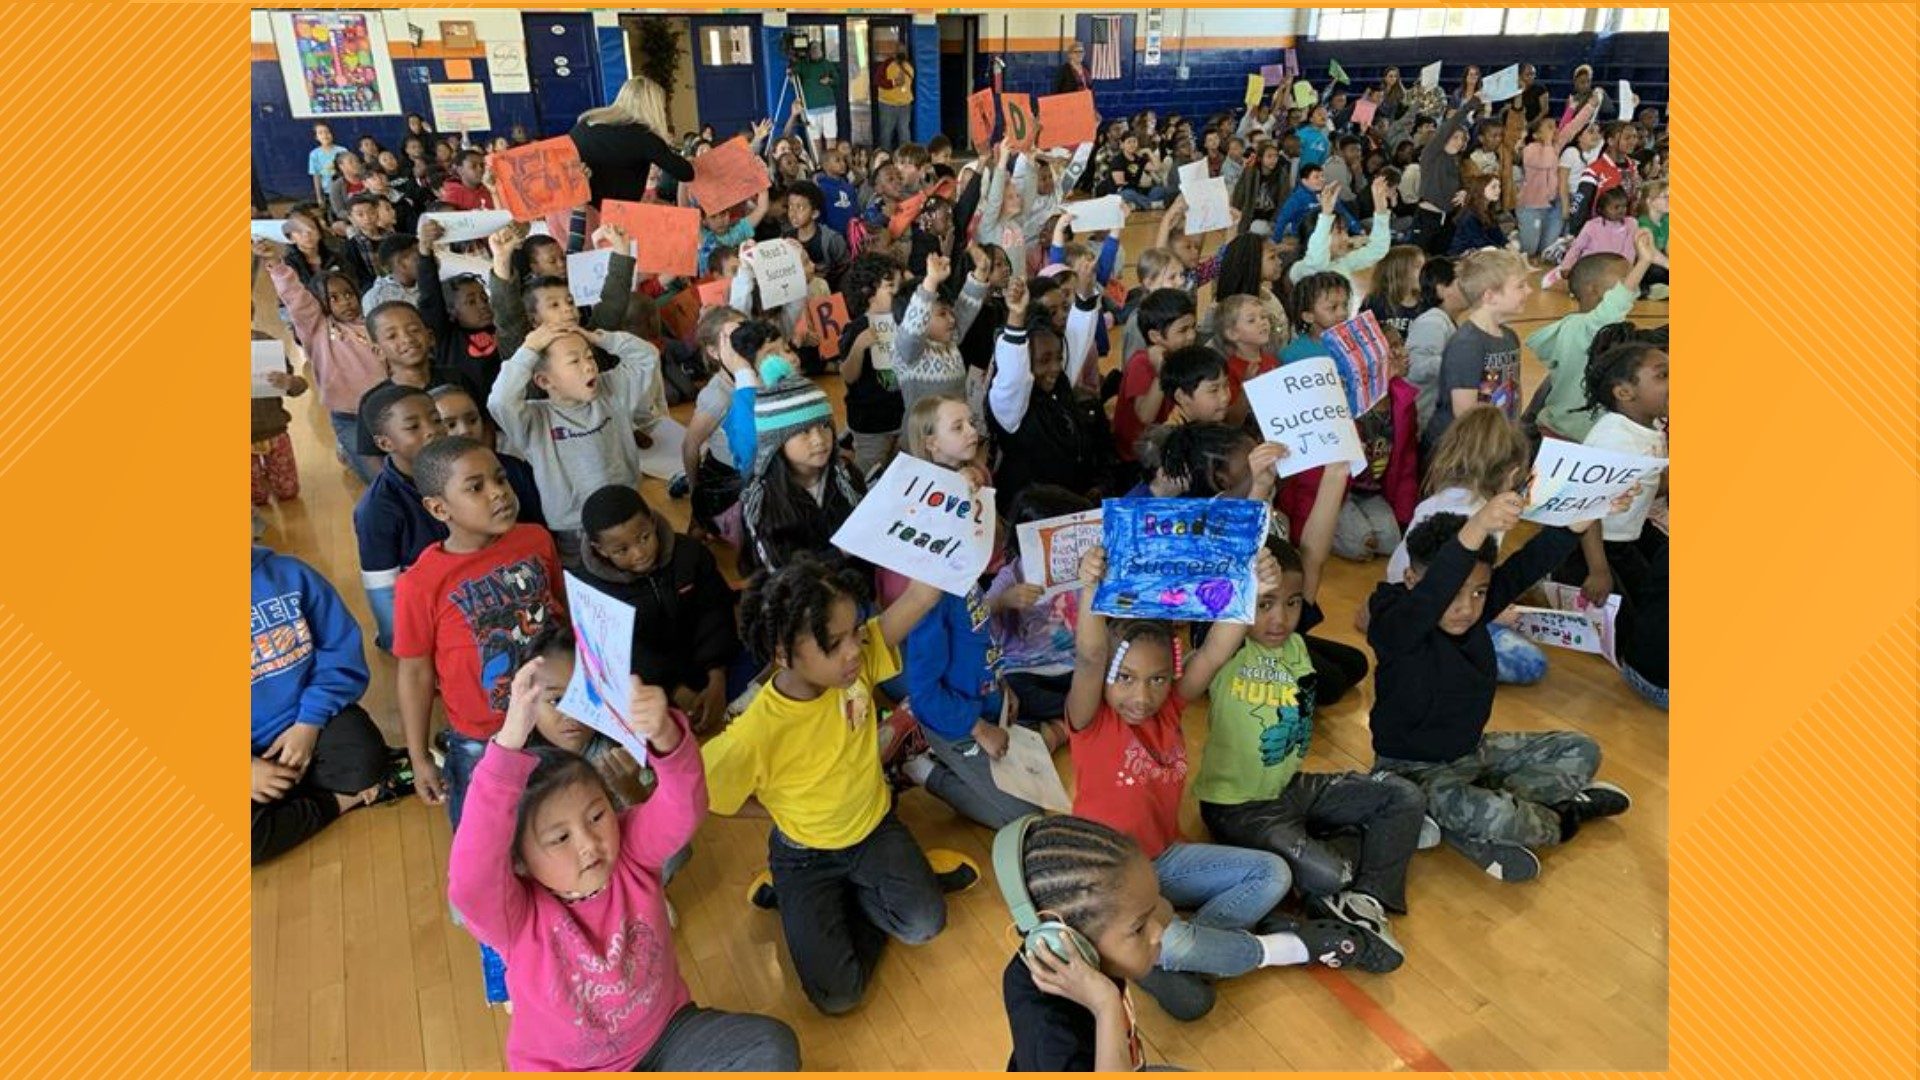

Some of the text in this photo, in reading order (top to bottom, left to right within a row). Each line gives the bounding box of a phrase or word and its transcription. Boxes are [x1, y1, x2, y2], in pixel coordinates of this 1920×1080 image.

[1008, 101, 1026, 140] D
[758, 245, 781, 260] Read
[766, 263, 796, 281] Succeed
[816, 302, 841, 340] R
[874, 320, 896, 333] LOV
[1284, 367, 1337, 394] Read
[1270, 404, 1348, 436] Succee
[1551, 457, 1641, 484] I LOVE
[904, 475, 919, 496] I
[918, 480, 972, 519] love
[1144, 512, 1208, 537] Read
[1128, 555, 1232, 577] Succeed
[1231, 678, 1300, 707] HULK
